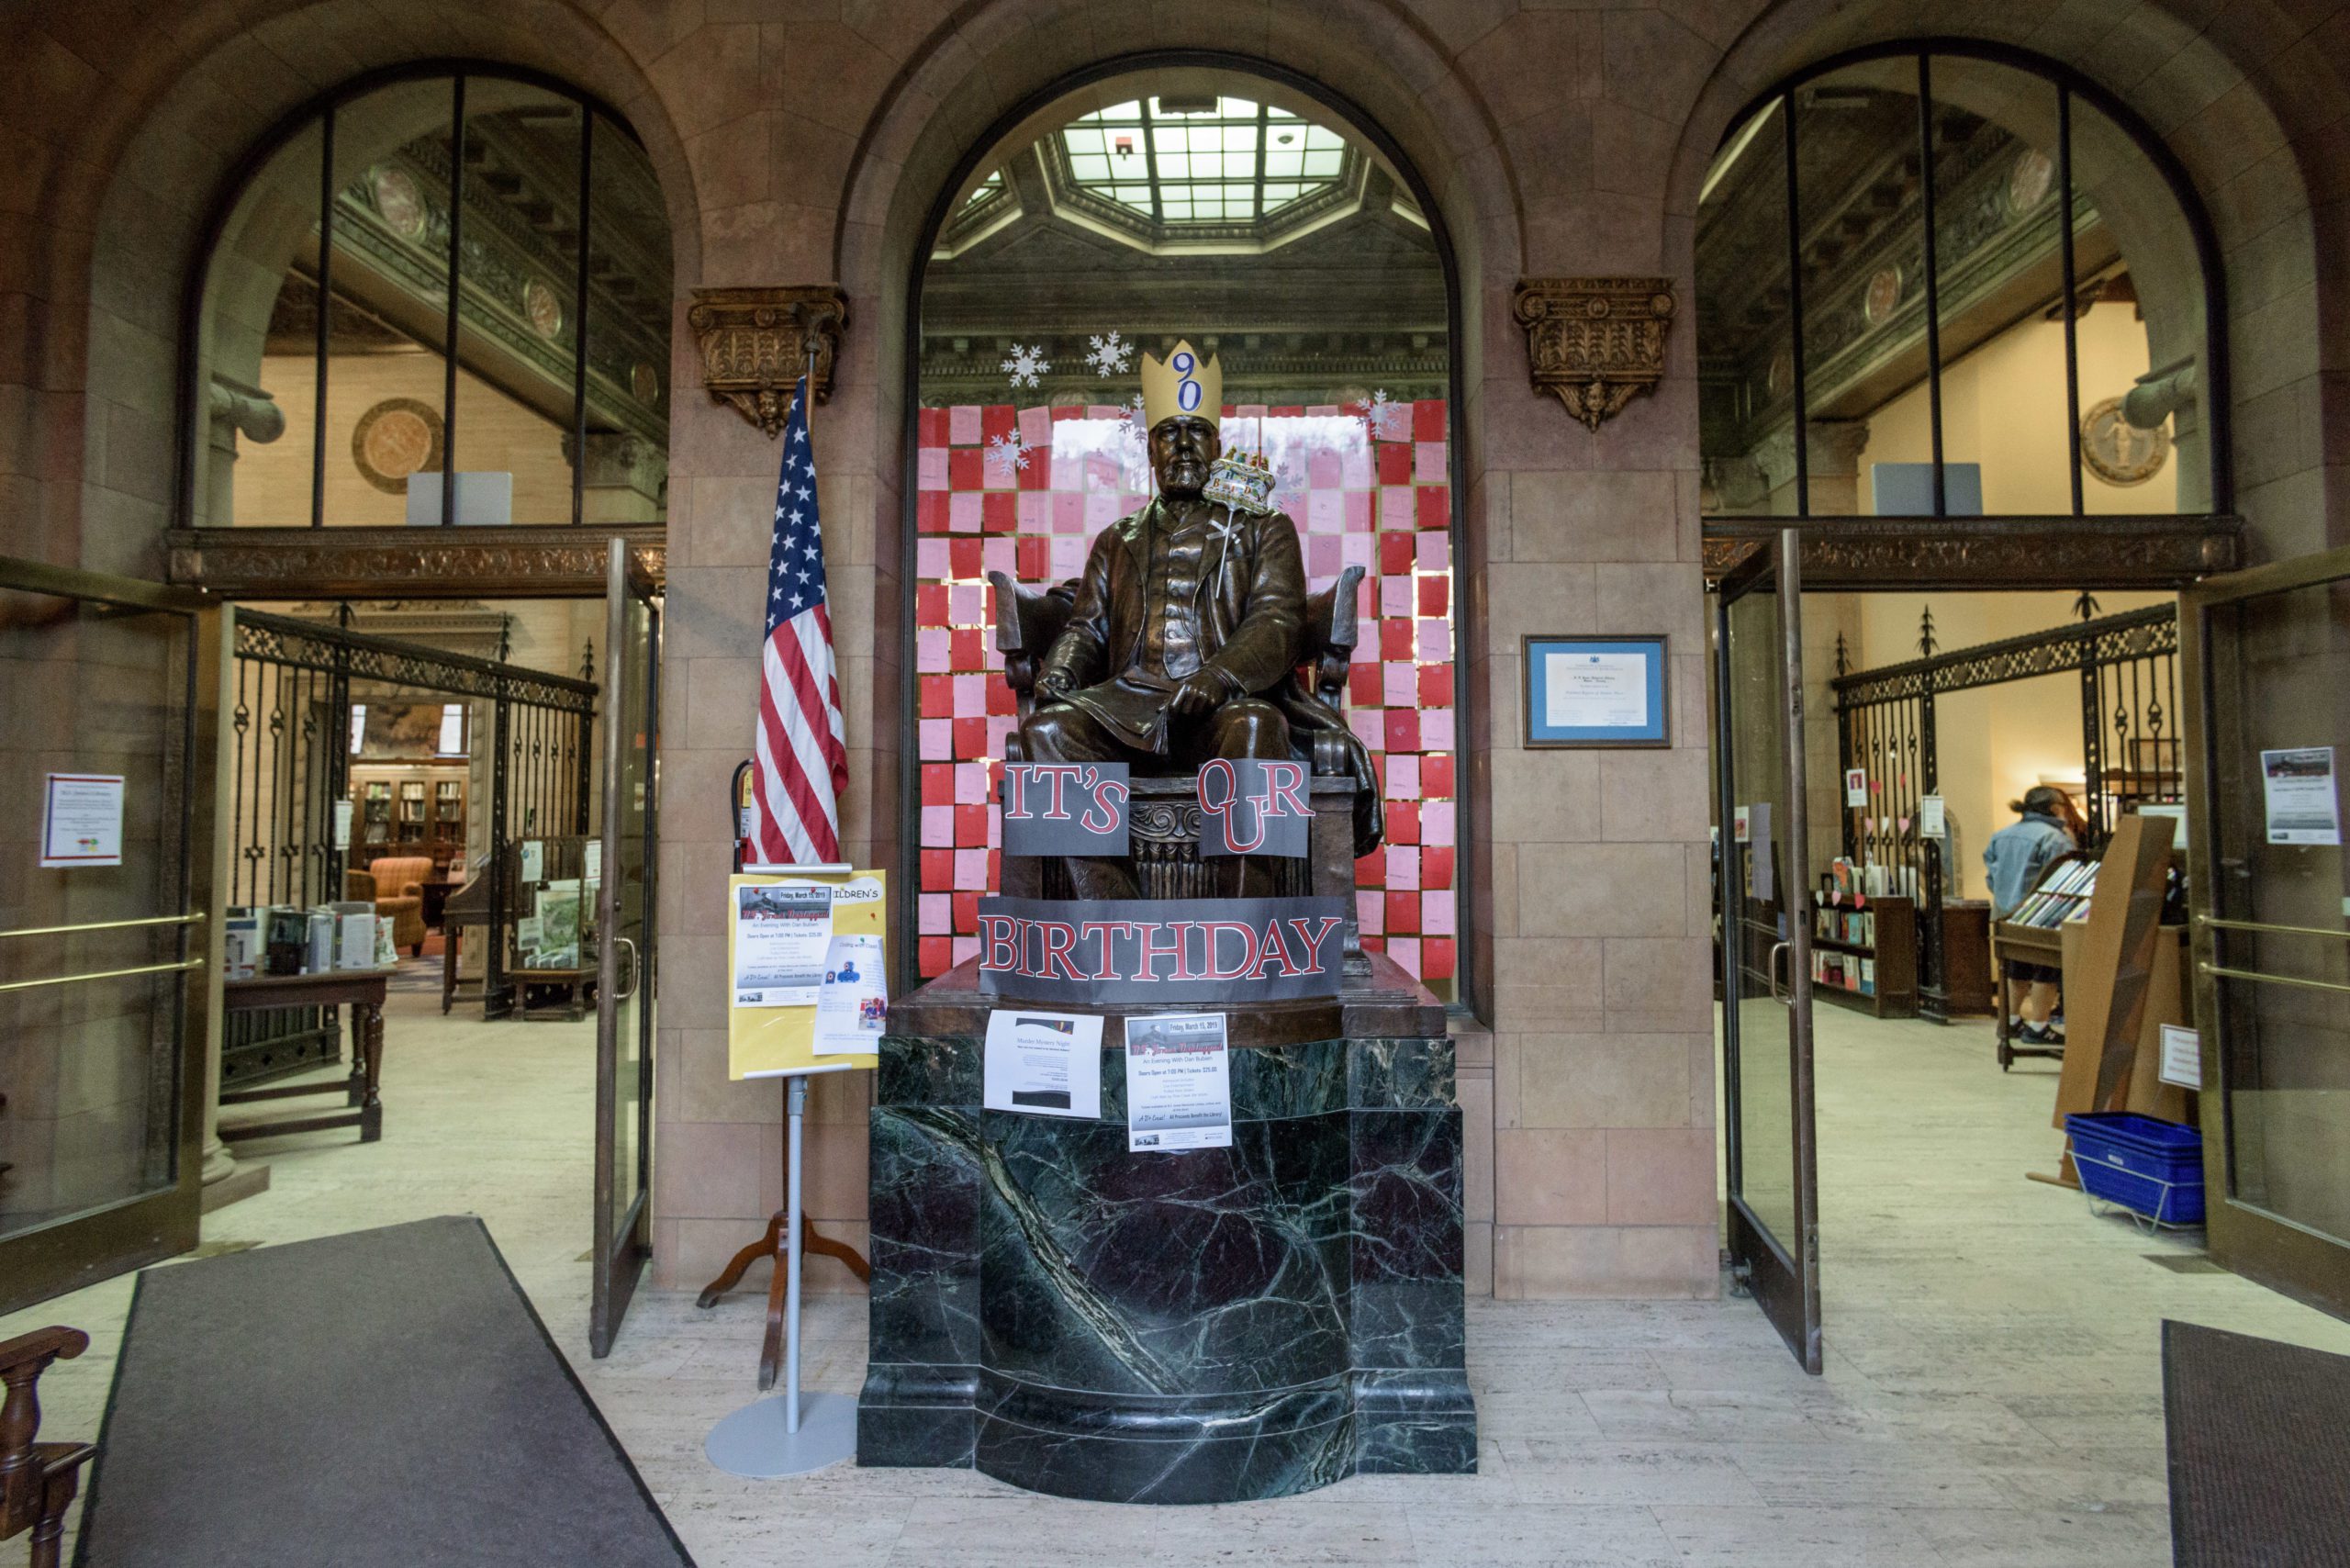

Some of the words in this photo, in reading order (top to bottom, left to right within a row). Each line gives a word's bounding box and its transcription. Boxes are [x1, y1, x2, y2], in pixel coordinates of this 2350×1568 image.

[1005, 764, 1130, 834] IT'S
[1197, 757, 1316, 854] OUR
[787, 910, 829, 921] Unplugged
[978, 914, 1343, 981] BIRTHDAY
[1170, 1024, 1185, 1032] Friday,
[1179, 1042, 1223, 1055] Unplugged
